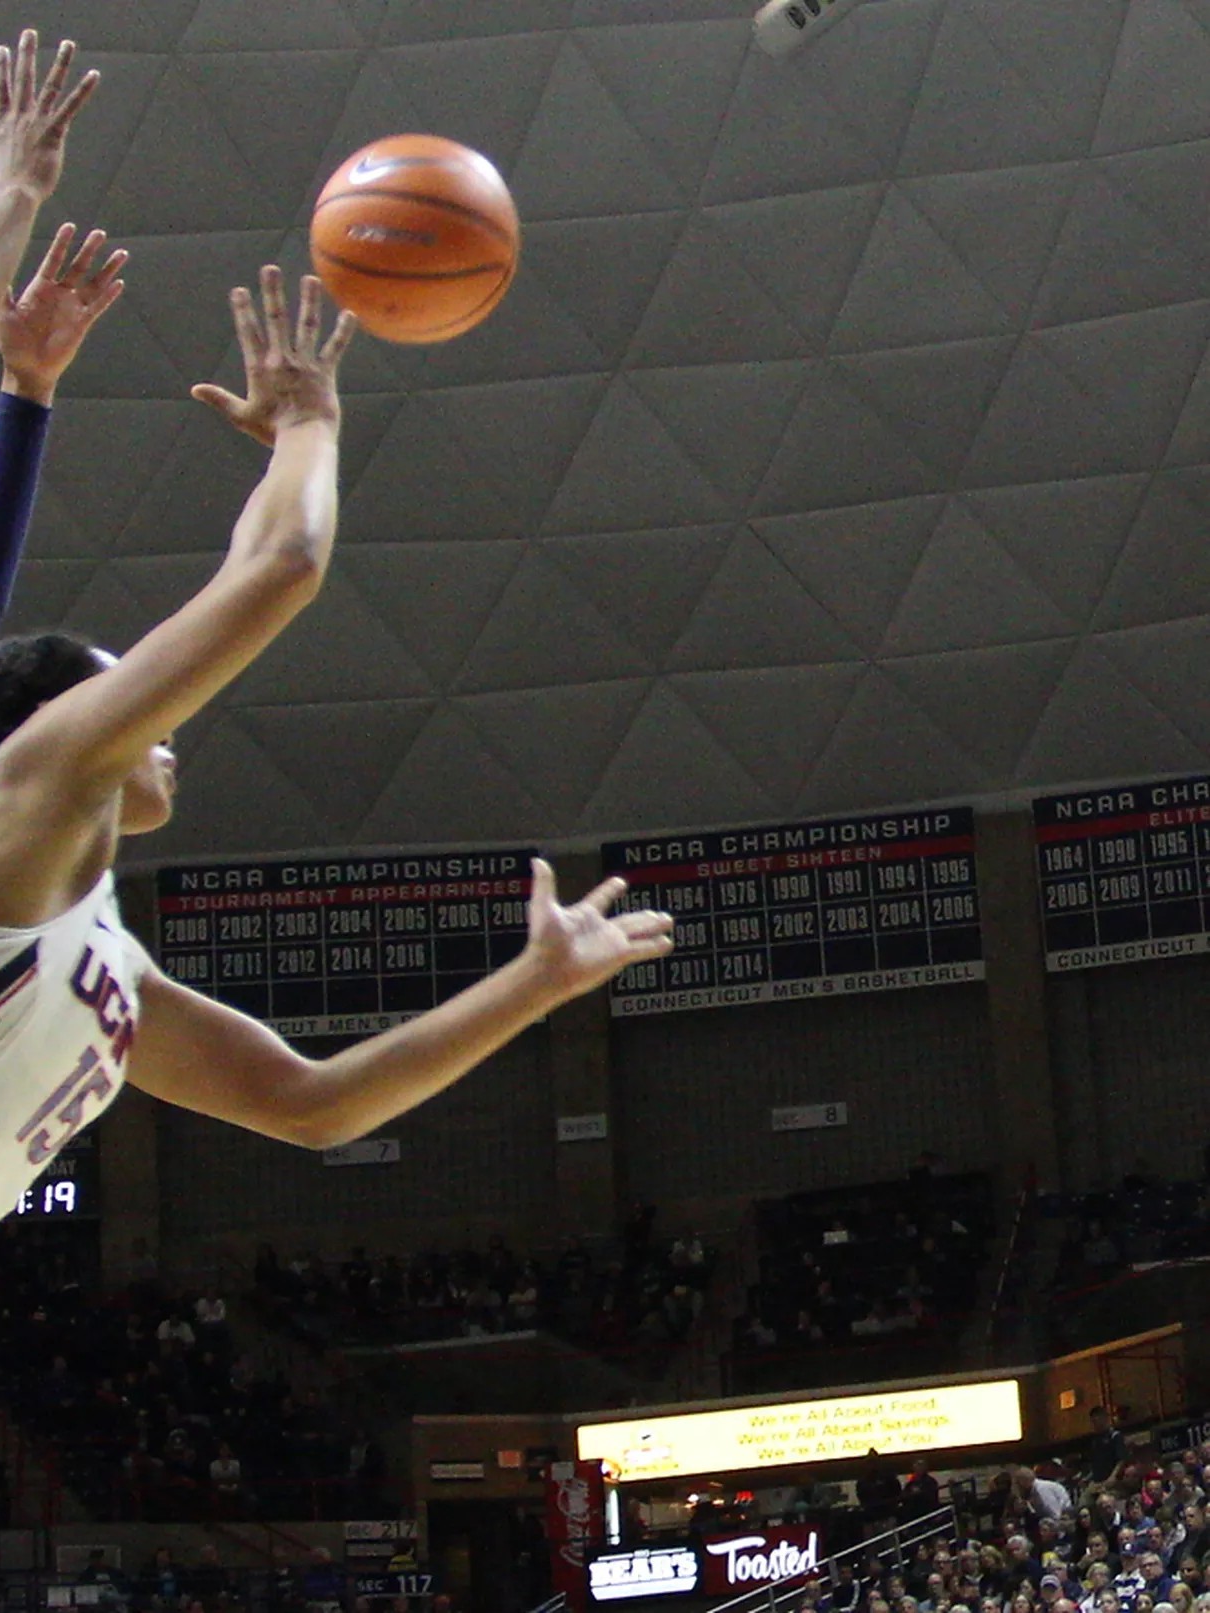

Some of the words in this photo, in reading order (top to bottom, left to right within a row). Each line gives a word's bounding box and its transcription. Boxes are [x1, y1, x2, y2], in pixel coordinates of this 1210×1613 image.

[1055, 792, 1135, 819] NCAA
[625, 840, 705, 864] NCAA
[720, 814, 950, 855] CHAMPIONSHIP
[1150, 830, 1187, 858] 1995
[181, 868, 264, 890] NCAA
[281, 856, 517, 885] CHAMPIONSHIP
[696, 856, 774, 877] SWEET
[786, 846, 882, 869] SIXTEEN
[179, 889, 337, 911] TOURNAMENT
[351, 880, 522, 901] APPEARANCES
[666, 885, 705, 912] 1964
[721, 880, 757, 906] 1976
[826, 868, 862, 897] 1991
[877, 864, 916, 890] 1994
[931, 858, 969, 886] 1995
[1153, 867, 1191, 895] 2011
[275, 912, 317, 937] 2003
[329, 908, 372, 934] 2004
[384, 906, 427, 932] 2005
[492, 900, 530, 926] 200
[722, 916, 760, 943] 1999
[773, 911, 814, 938] 2002
[826, 905, 868, 932] 2003
[879, 899, 921, 927] 2004
[222, 952, 263, 977] 2011
[277, 949, 316, 974] 2012
[331, 946, 372, 972] 2014
[386, 943, 426, 969] 2016
[669, 958, 709, 985] 2011
[722, 953, 763, 980] 2014
[1057, 939, 1195, 968] CONNECTICUT
[622, 986, 762, 1013] CONNECTICUT
[844, 965, 975, 990] BASKETBALL
[826, 1106, 837, 1122] 8
[378, 1142, 389, 1161] 7
[706, 1530, 820, 1585] Toasted
[396, 1573, 433, 1594] 117
